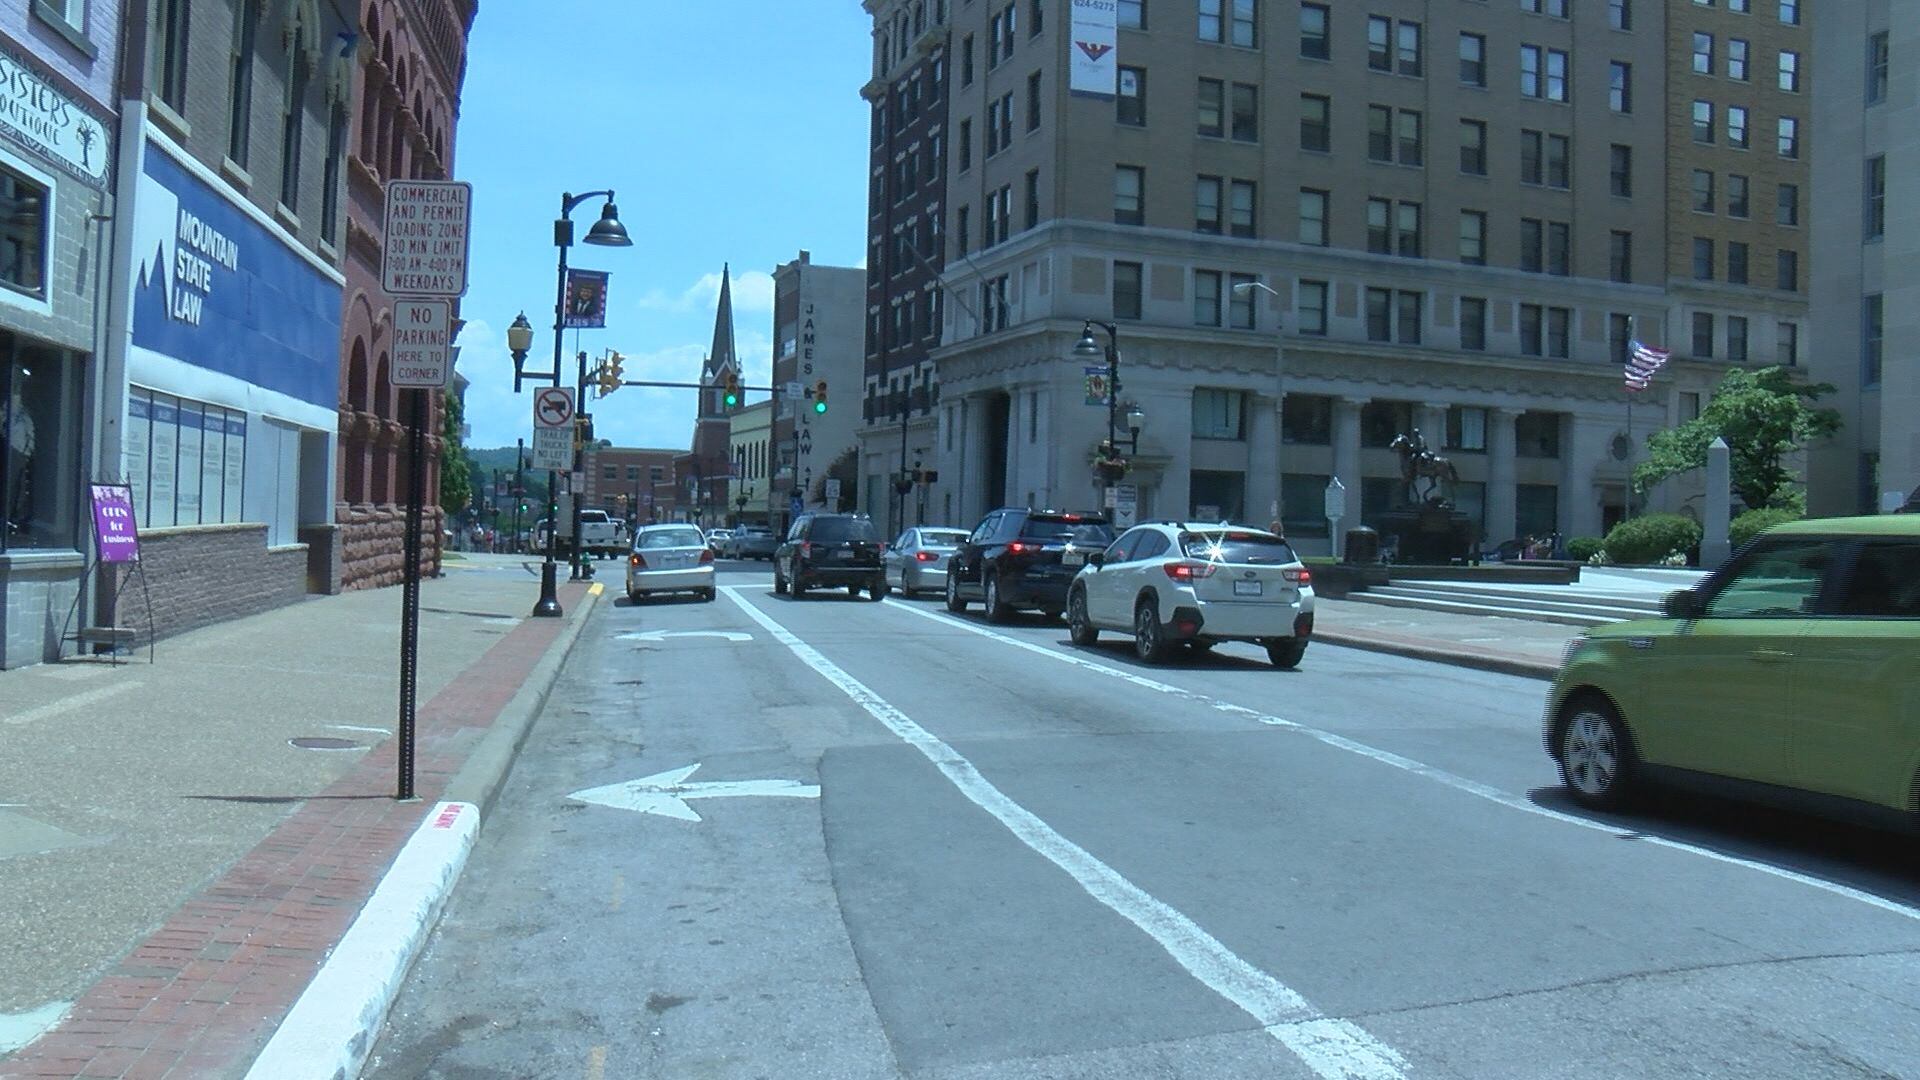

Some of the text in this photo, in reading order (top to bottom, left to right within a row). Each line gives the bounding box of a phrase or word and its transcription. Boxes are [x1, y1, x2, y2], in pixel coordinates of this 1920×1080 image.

[394, 187, 464, 204] COMMERCIAL
[393, 204, 464, 220] AND PERMIT
[390, 222, 463, 238] LOADING ZONE
[180, 208, 238, 271] MOUNTAIN
[391, 239, 460, 255] 30 MIN LIMIT
[177, 247, 211, 292] STATE
[387, 256, 406, 271] 7:00
[449, 258, 462, 272] PM
[394, 274, 455, 290] WEEKDAYS
[174, 286, 202, 326] LAW
[411, 307, 432, 324] NO
[396, 329, 445, 345] PARKING
[803, 303, 815, 375] JAMES
[396, 350, 442, 363] HERE TO
[398, 367, 439, 379] CORNER
[800, 413, 812, 455] LAW
